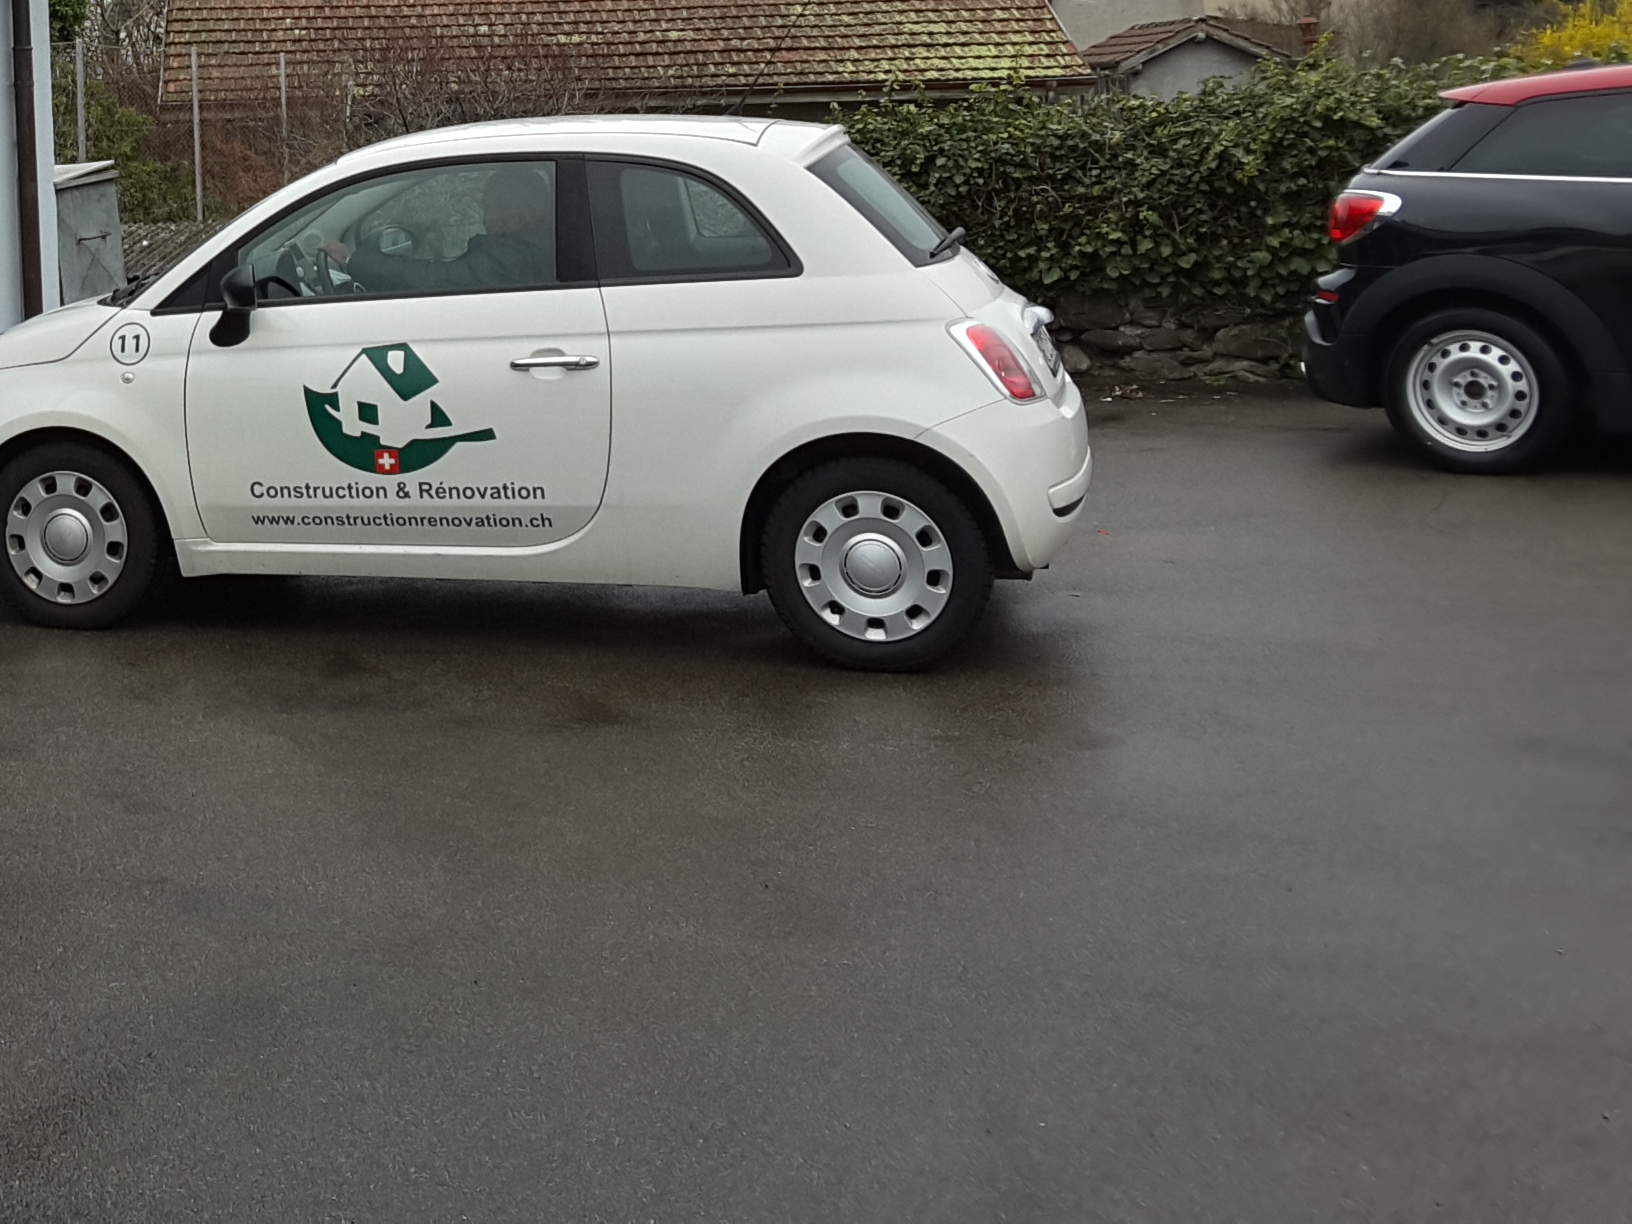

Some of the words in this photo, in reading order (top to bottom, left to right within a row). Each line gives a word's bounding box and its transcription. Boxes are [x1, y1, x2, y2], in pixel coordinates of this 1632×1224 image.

[117, 334, 141, 354] 11
[250, 482, 388, 501] Construction
[396, 483, 411, 500] &
[418, 482, 546, 501] Rénovation
[251, 511, 553, 528] www.constructionrenovation.ch
